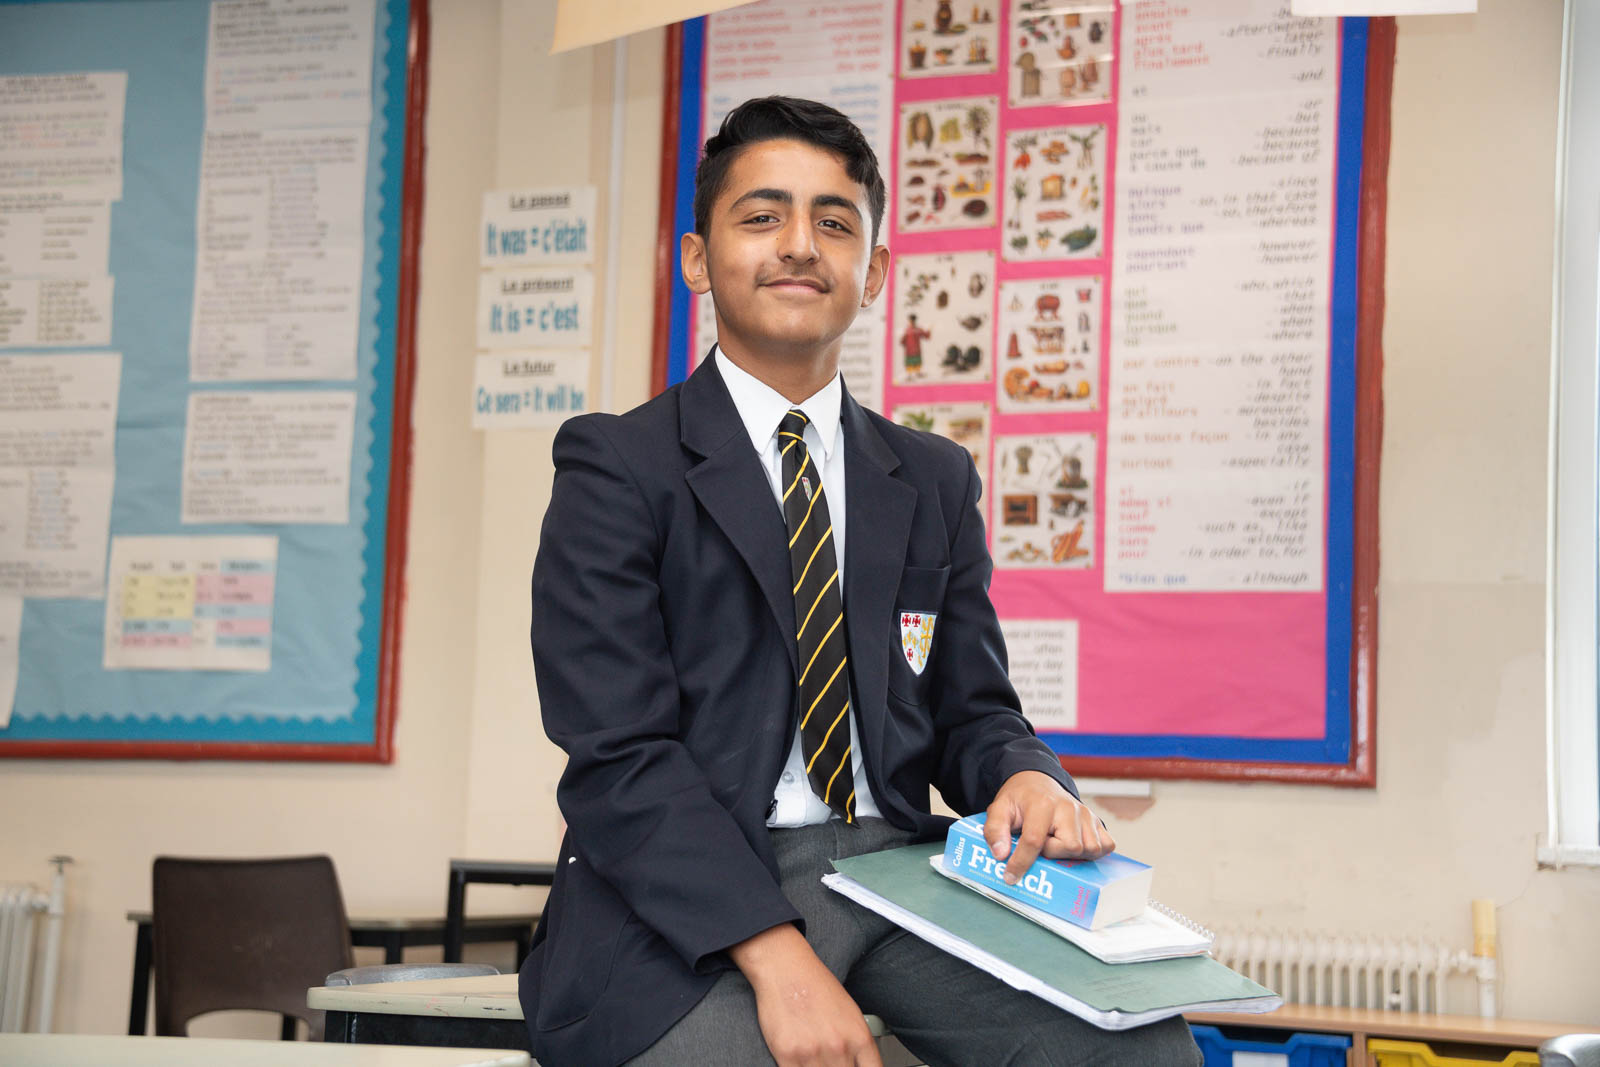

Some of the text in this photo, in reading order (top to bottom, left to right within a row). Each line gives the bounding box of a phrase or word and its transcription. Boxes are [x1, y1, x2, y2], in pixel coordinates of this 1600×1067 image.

[509, 195, 527, 211] Le
[500, 229, 527, 256] was
[501, 278, 518, 294] Le
[507, 304, 520, 333] is
[539, 301, 579, 332] c'est
[503, 360, 520, 376] Le
[952, 836, 966, 867] Collins
